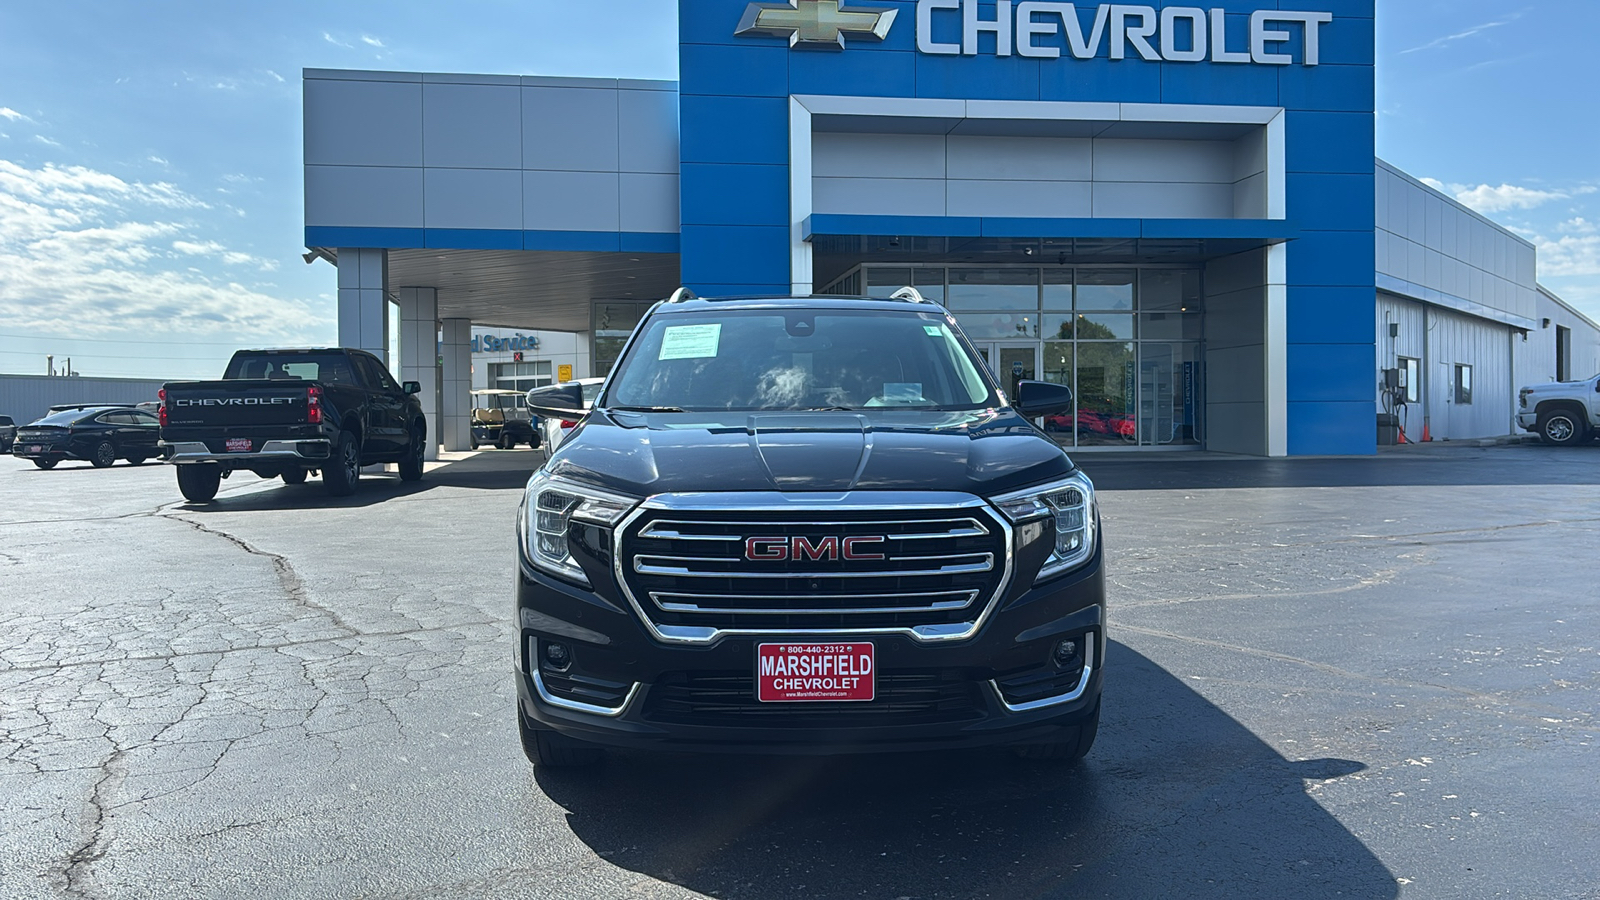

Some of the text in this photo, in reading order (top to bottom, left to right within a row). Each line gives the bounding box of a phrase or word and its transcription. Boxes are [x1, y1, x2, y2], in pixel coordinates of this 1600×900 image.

[916, 0, 1332, 66] CHEVROLET
[483, 332, 536, 351] Service
[176, 397, 297, 407] CHEVROLET
[745, 536, 885, 561] GMC
[761, 655, 872, 676] MARSHFIELD
[773, 678, 860, 690] CHEVROLET
